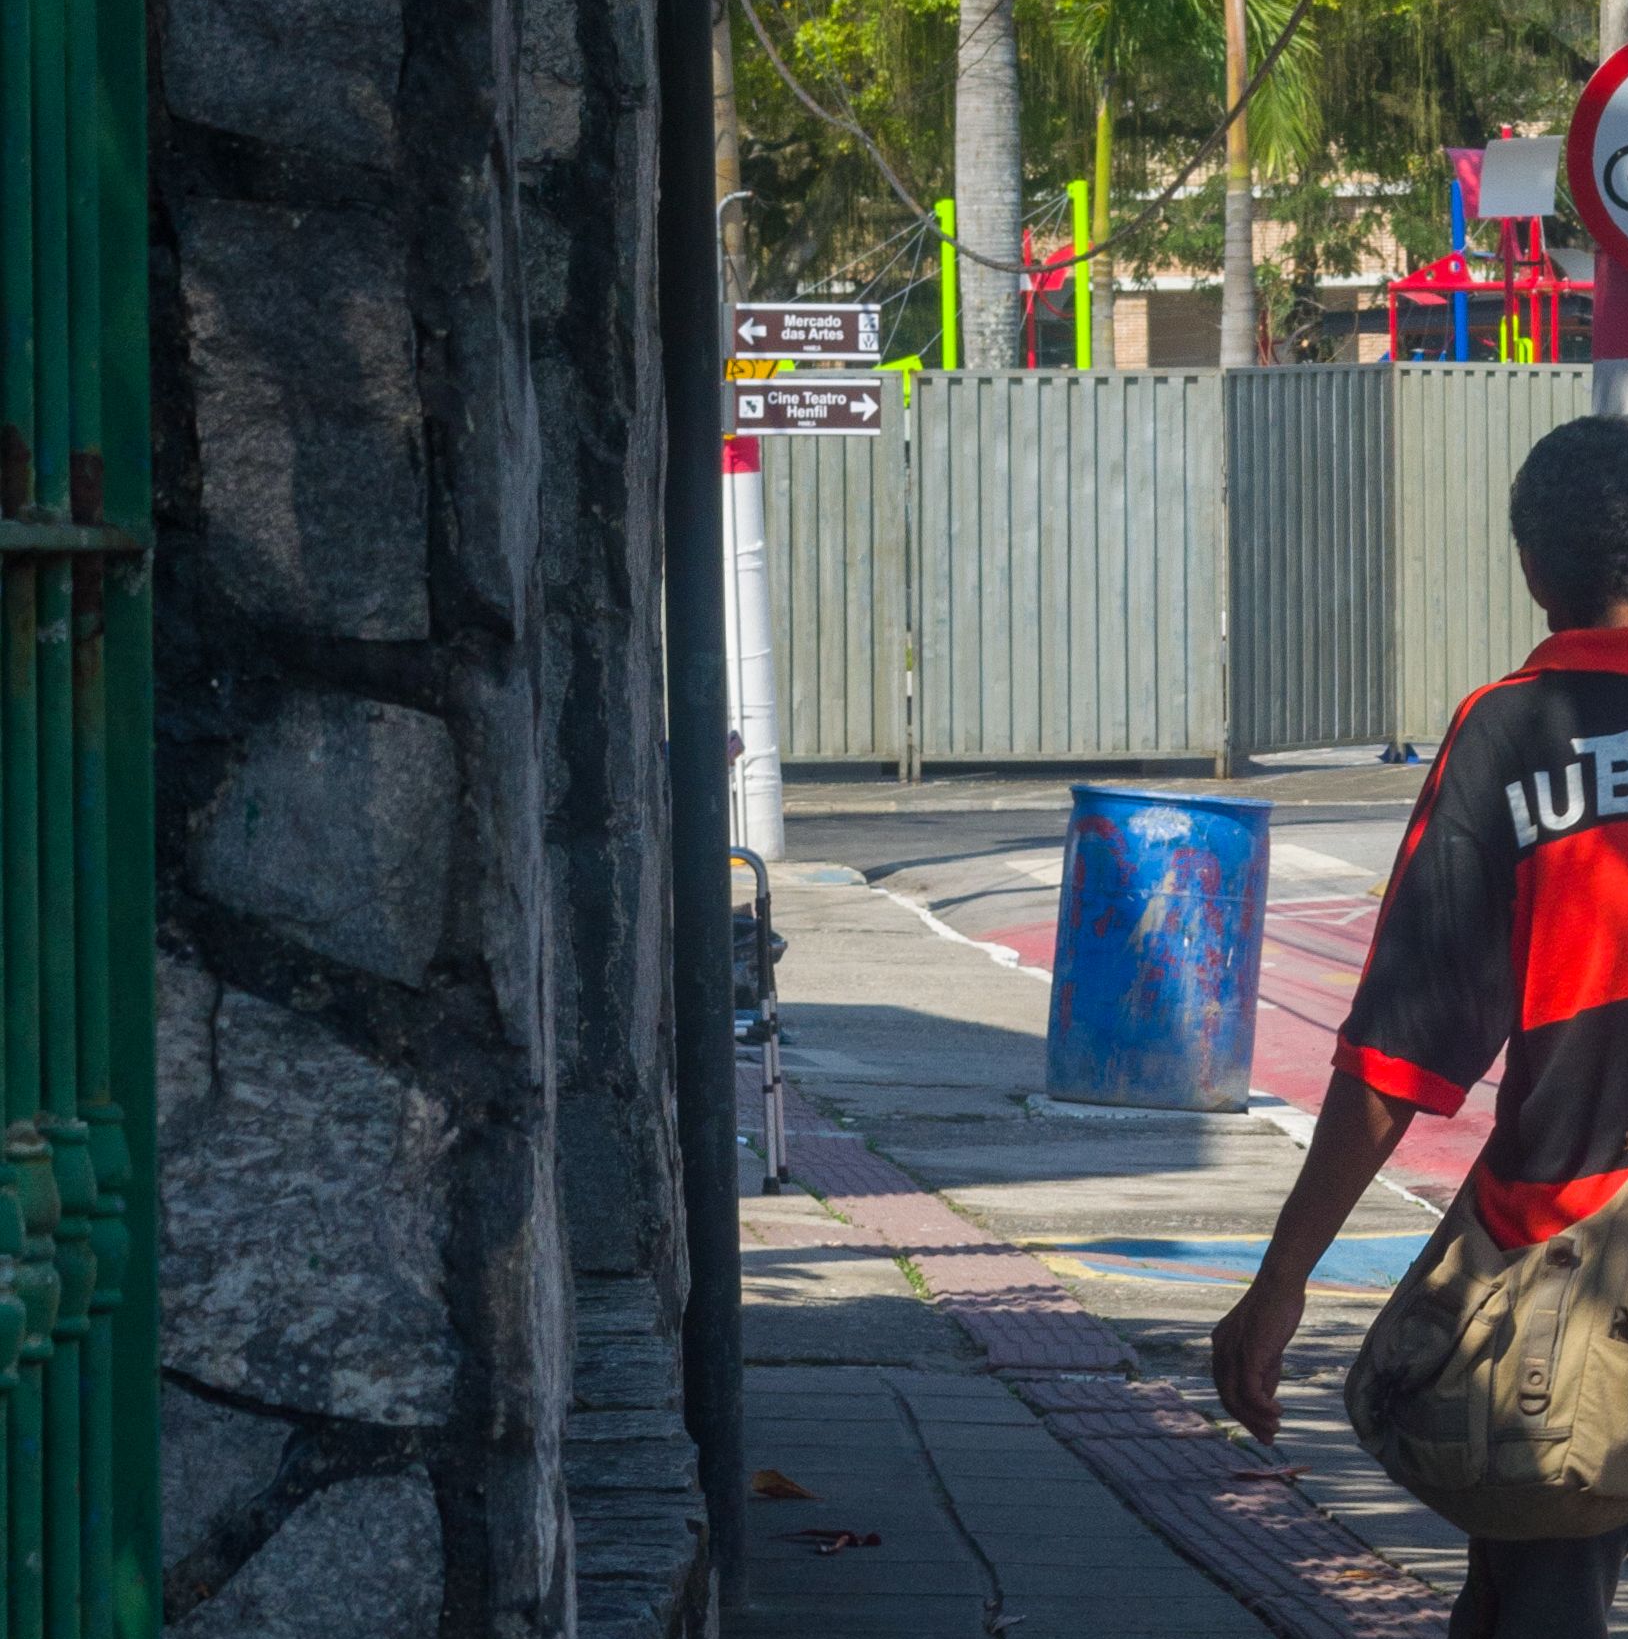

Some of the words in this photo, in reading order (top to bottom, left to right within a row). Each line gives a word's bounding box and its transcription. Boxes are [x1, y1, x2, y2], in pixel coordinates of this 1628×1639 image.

[784, 314, 842, 328] Mercado
[781, 328, 806, 341] das
[808, 327, 845, 341] Artes
[767, 391, 800, 405] Cine
[802, 391, 847, 405] Teatro
[786, 404, 828, 419] Henfil
